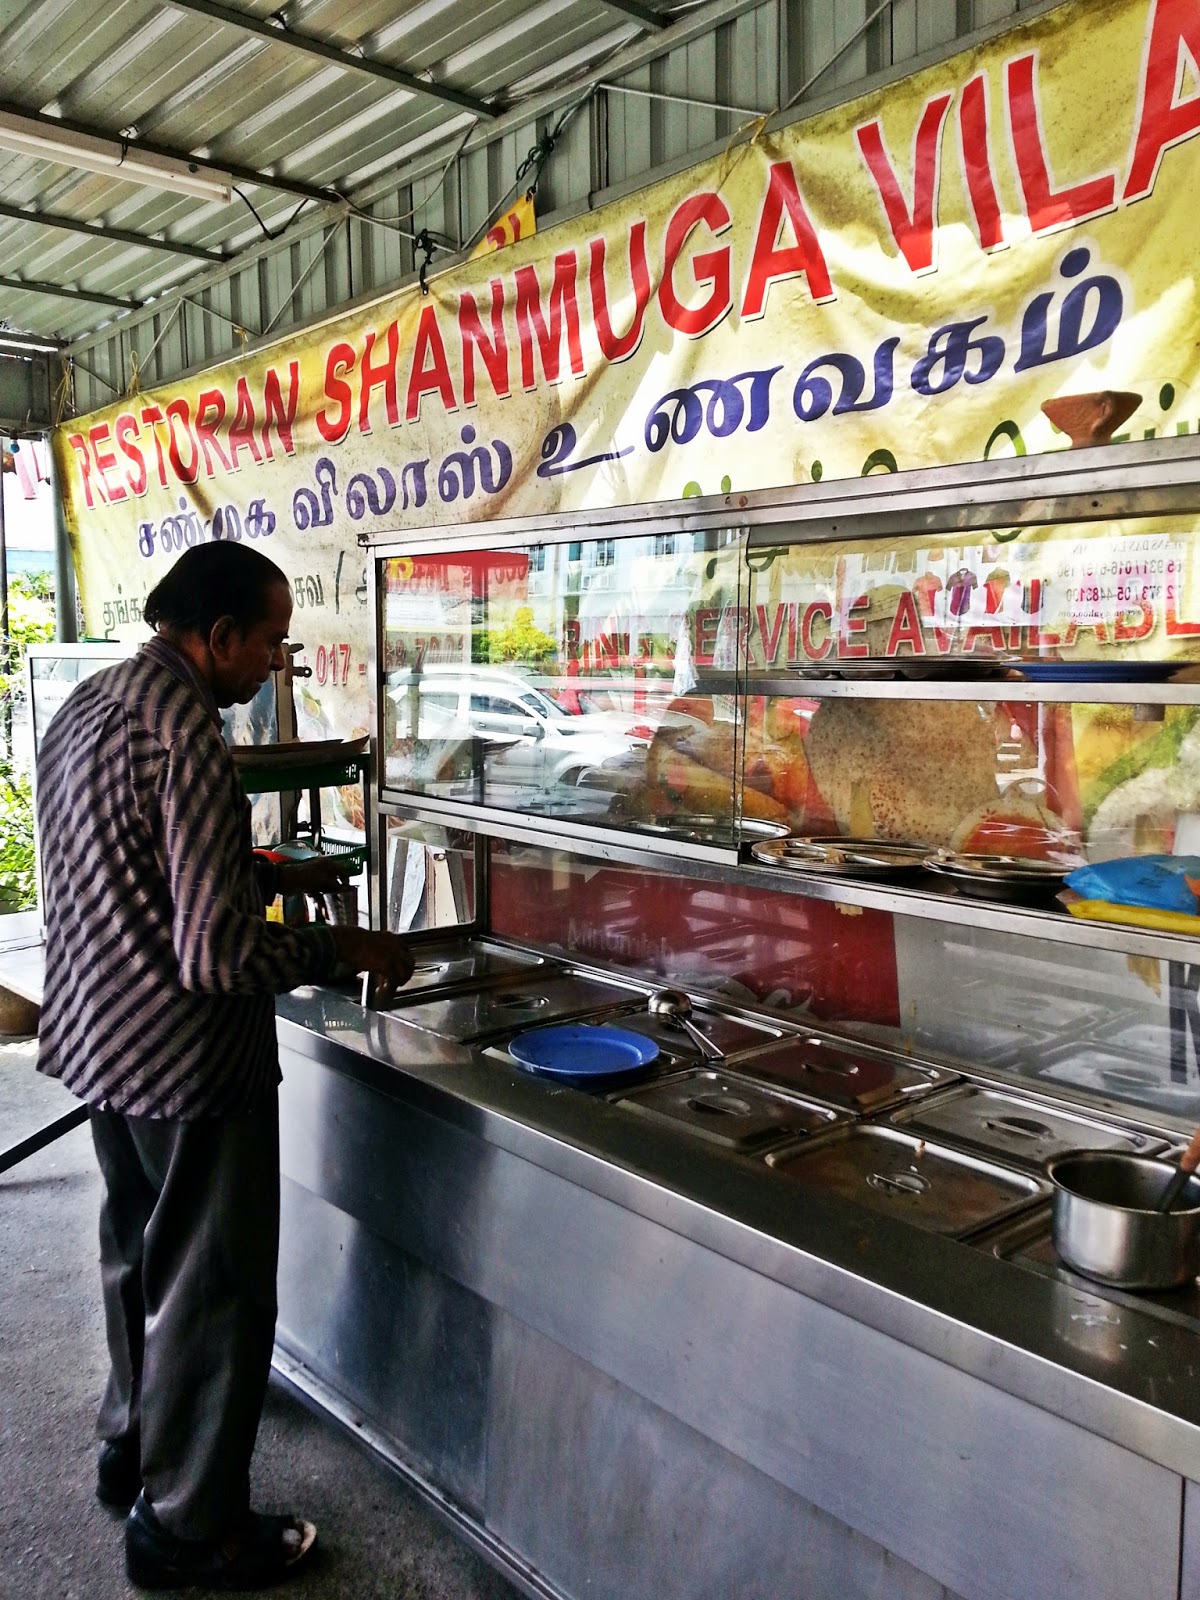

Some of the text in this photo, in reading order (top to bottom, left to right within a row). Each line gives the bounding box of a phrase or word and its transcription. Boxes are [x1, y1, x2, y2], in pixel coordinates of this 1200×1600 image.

[67, 361, 299, 509] RESTORAN
[315, 161, 835, 444] SHANMUGA
[293, 425, 513, 531] விலாஸ்
[537, 247, 1123, 478] உணவகம்
[315, 643, 351, 686] 017
